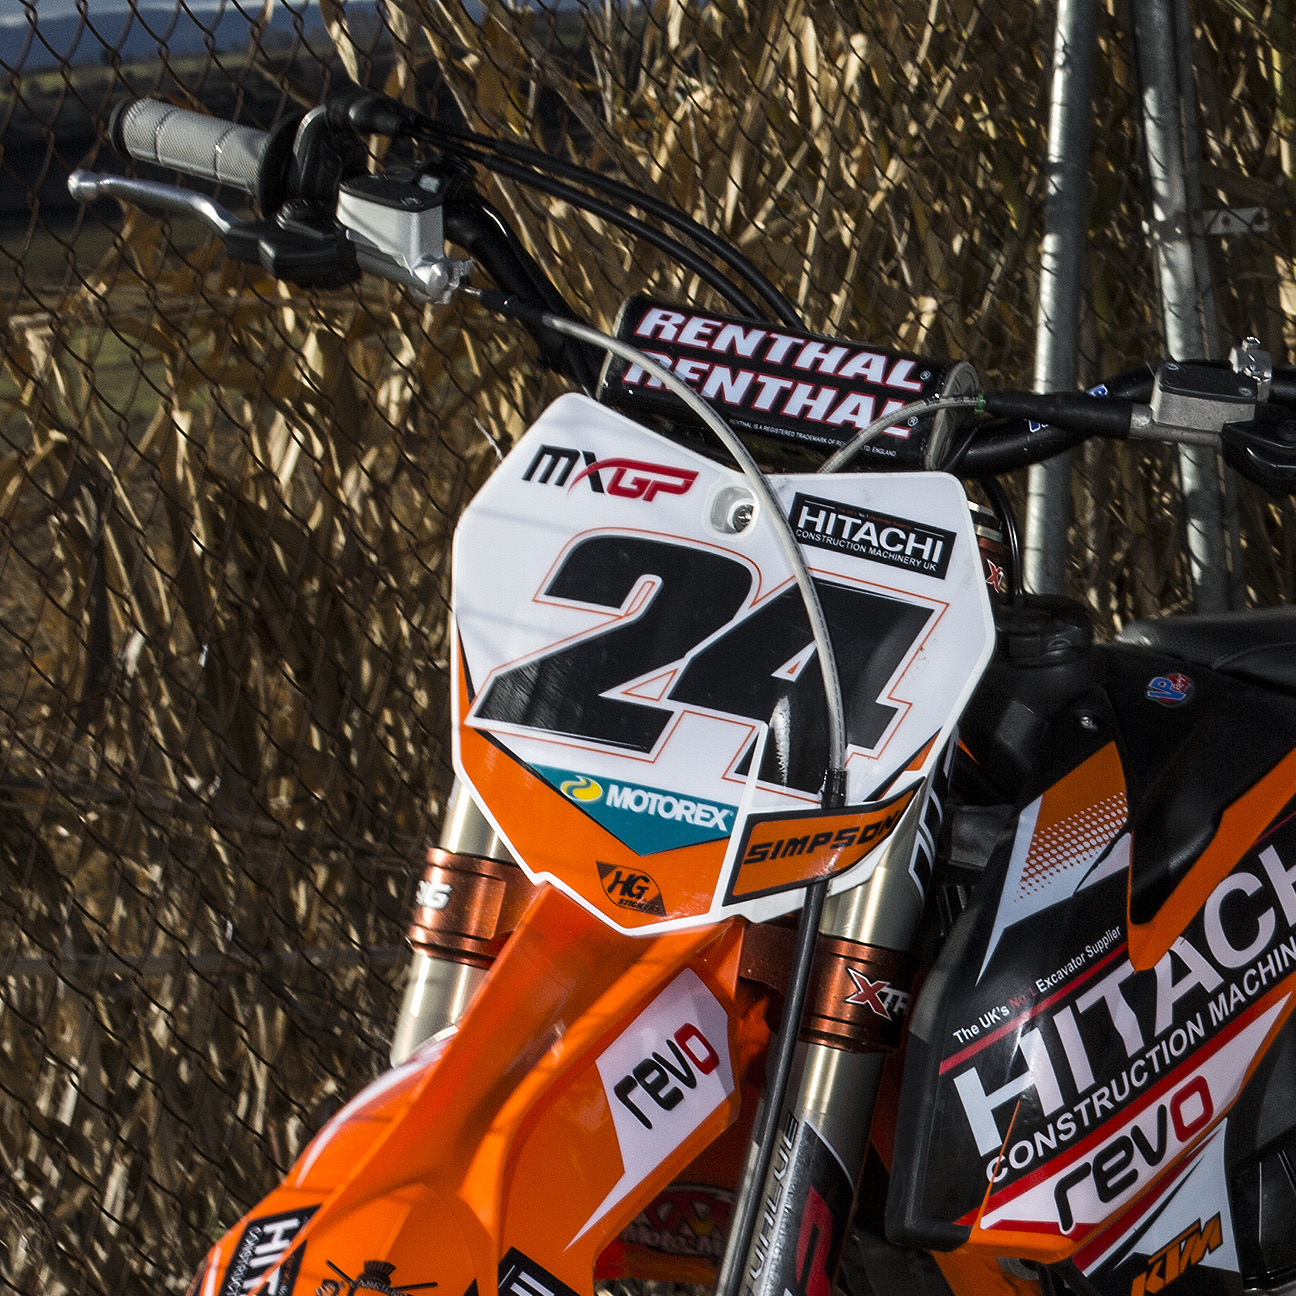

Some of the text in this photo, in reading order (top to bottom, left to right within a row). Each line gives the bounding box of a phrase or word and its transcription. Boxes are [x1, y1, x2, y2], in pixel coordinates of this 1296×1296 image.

[633, 307, 924, 392] RENTHAL
[622, 349, 911, 439] RENTHAL
[521, 444, 700, 503] MXGP
[795, 529, 936, 572] CONSTRUCTION MACHINERY UK
[797, 506, 943, 563] HITACHI
[473, 534, 938, 798] 24
[606, 784, 731, 832] MOTOREX
[743, 808, 899, 865] SIMPSON
[607, 870, 651, 901] HG
[953, 1022, 980, 1044] The
[978, 1004, 1010, 1029] UK's
[1035, 952, 1086, 993] Excavator
[1085, 926, 1121, 958] Supplier
[612, 1022, 721, 1130] revo
[986, 1012, 1206, 1184] CONSTRUCTION
[1054, 1075, 1213, 1236] revo
